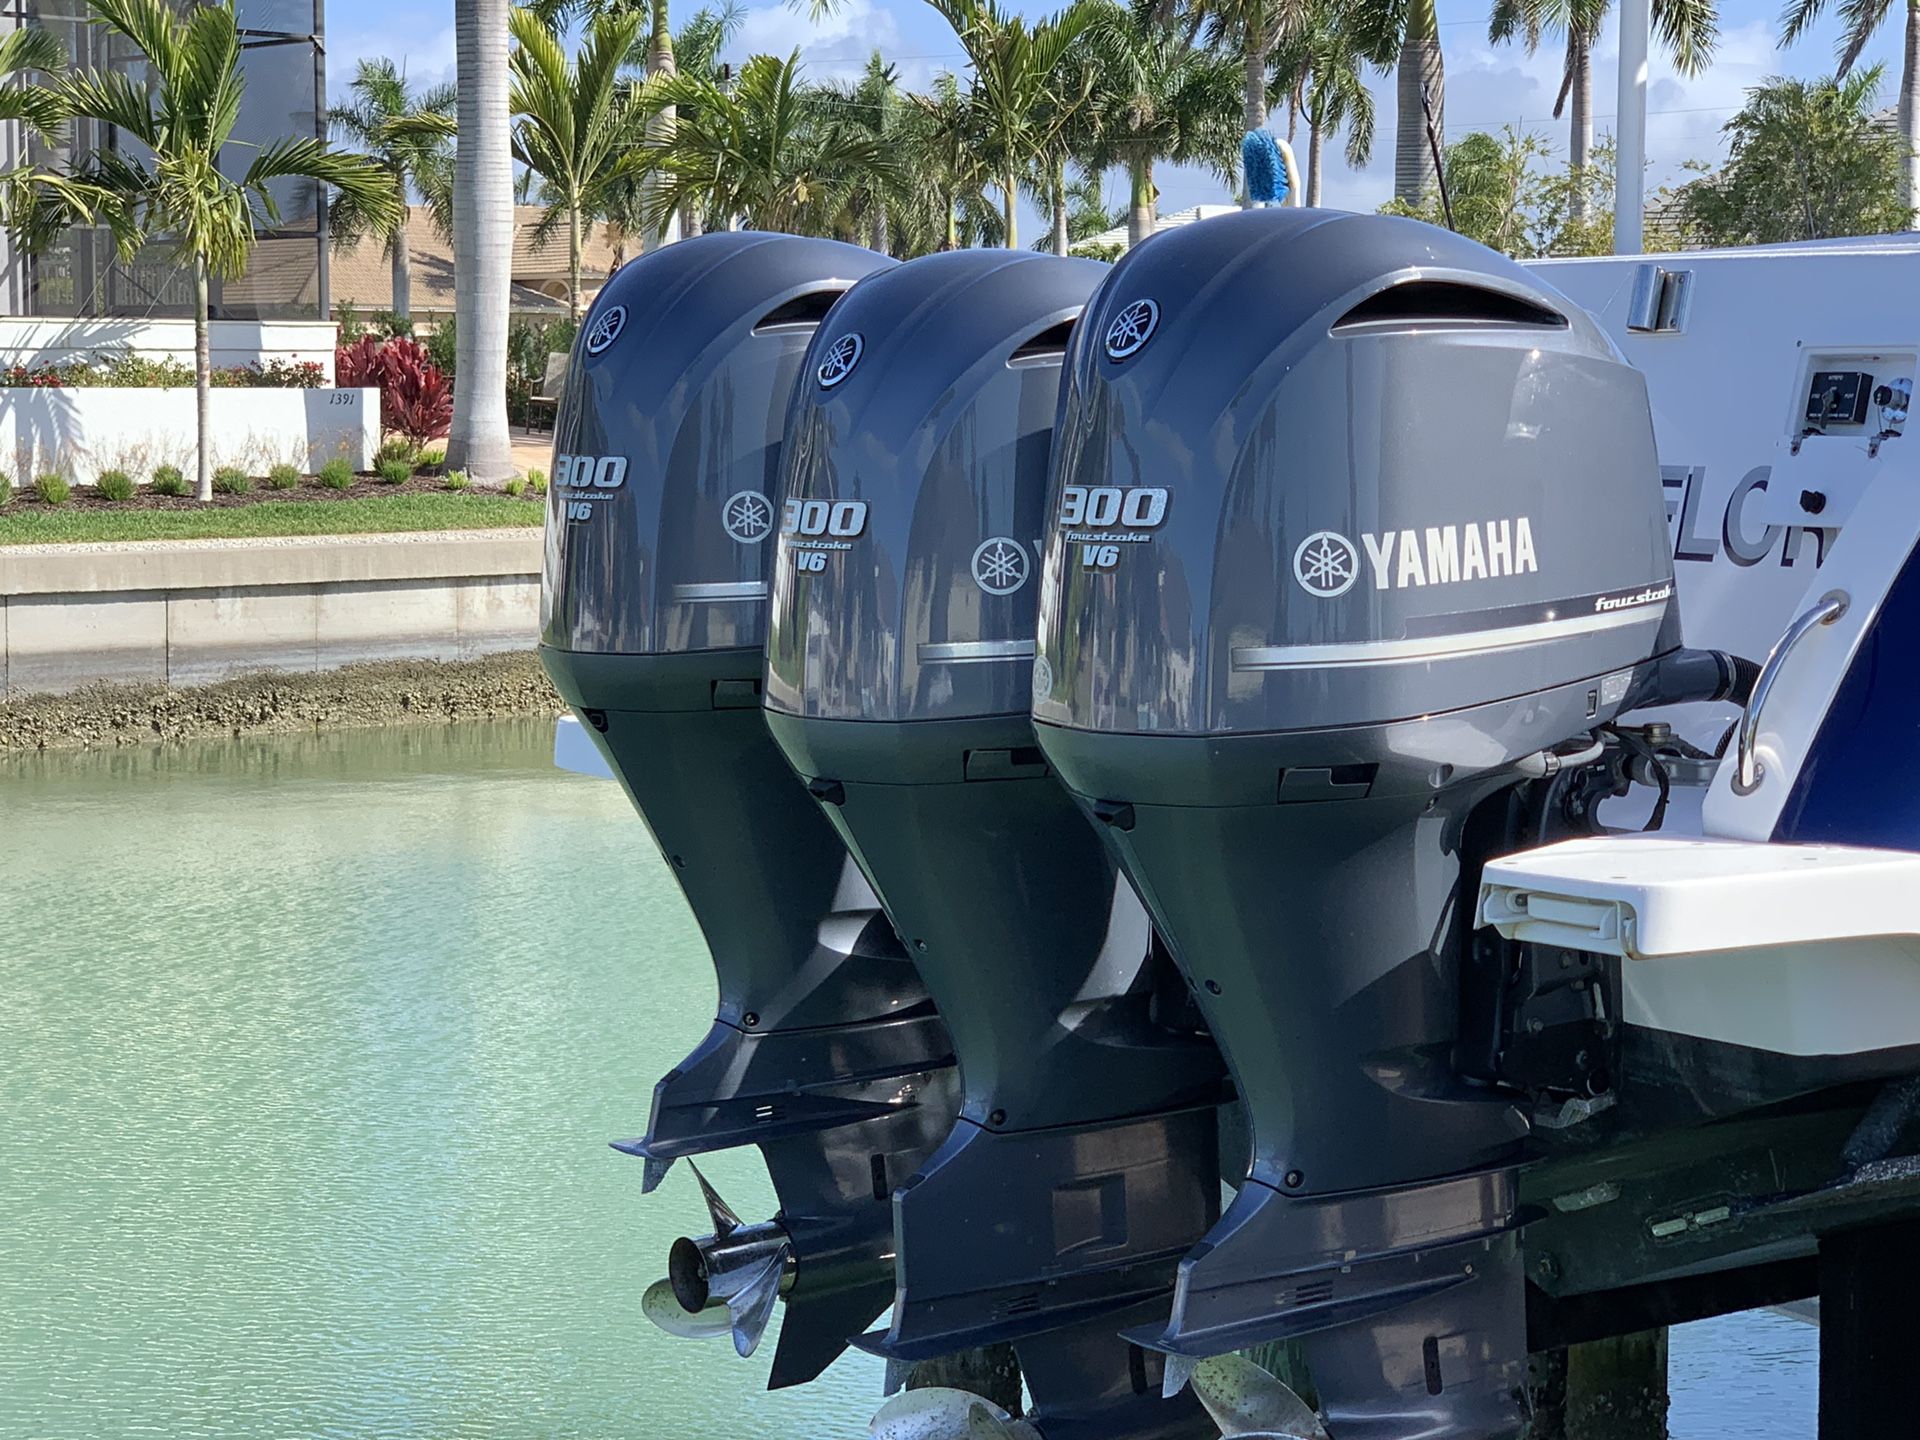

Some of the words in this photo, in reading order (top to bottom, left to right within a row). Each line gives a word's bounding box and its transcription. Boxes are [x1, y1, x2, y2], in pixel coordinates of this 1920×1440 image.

[330, 393, 354, 405] 1391
[556, 455, 628, 488] 300
[559, 491, 614, 500] urstroke
[567, 502, 592, 520] V6
[1060, 487, 1168, 527] 300
[782, 500, 867, 536] 300
[1065, 531, 1151, 542] fourstroke
[797, 552, 828, 572] V6
[1083, 545, 1120, 567] V6
[1361, 517, 1538, 590] YAMAHA
